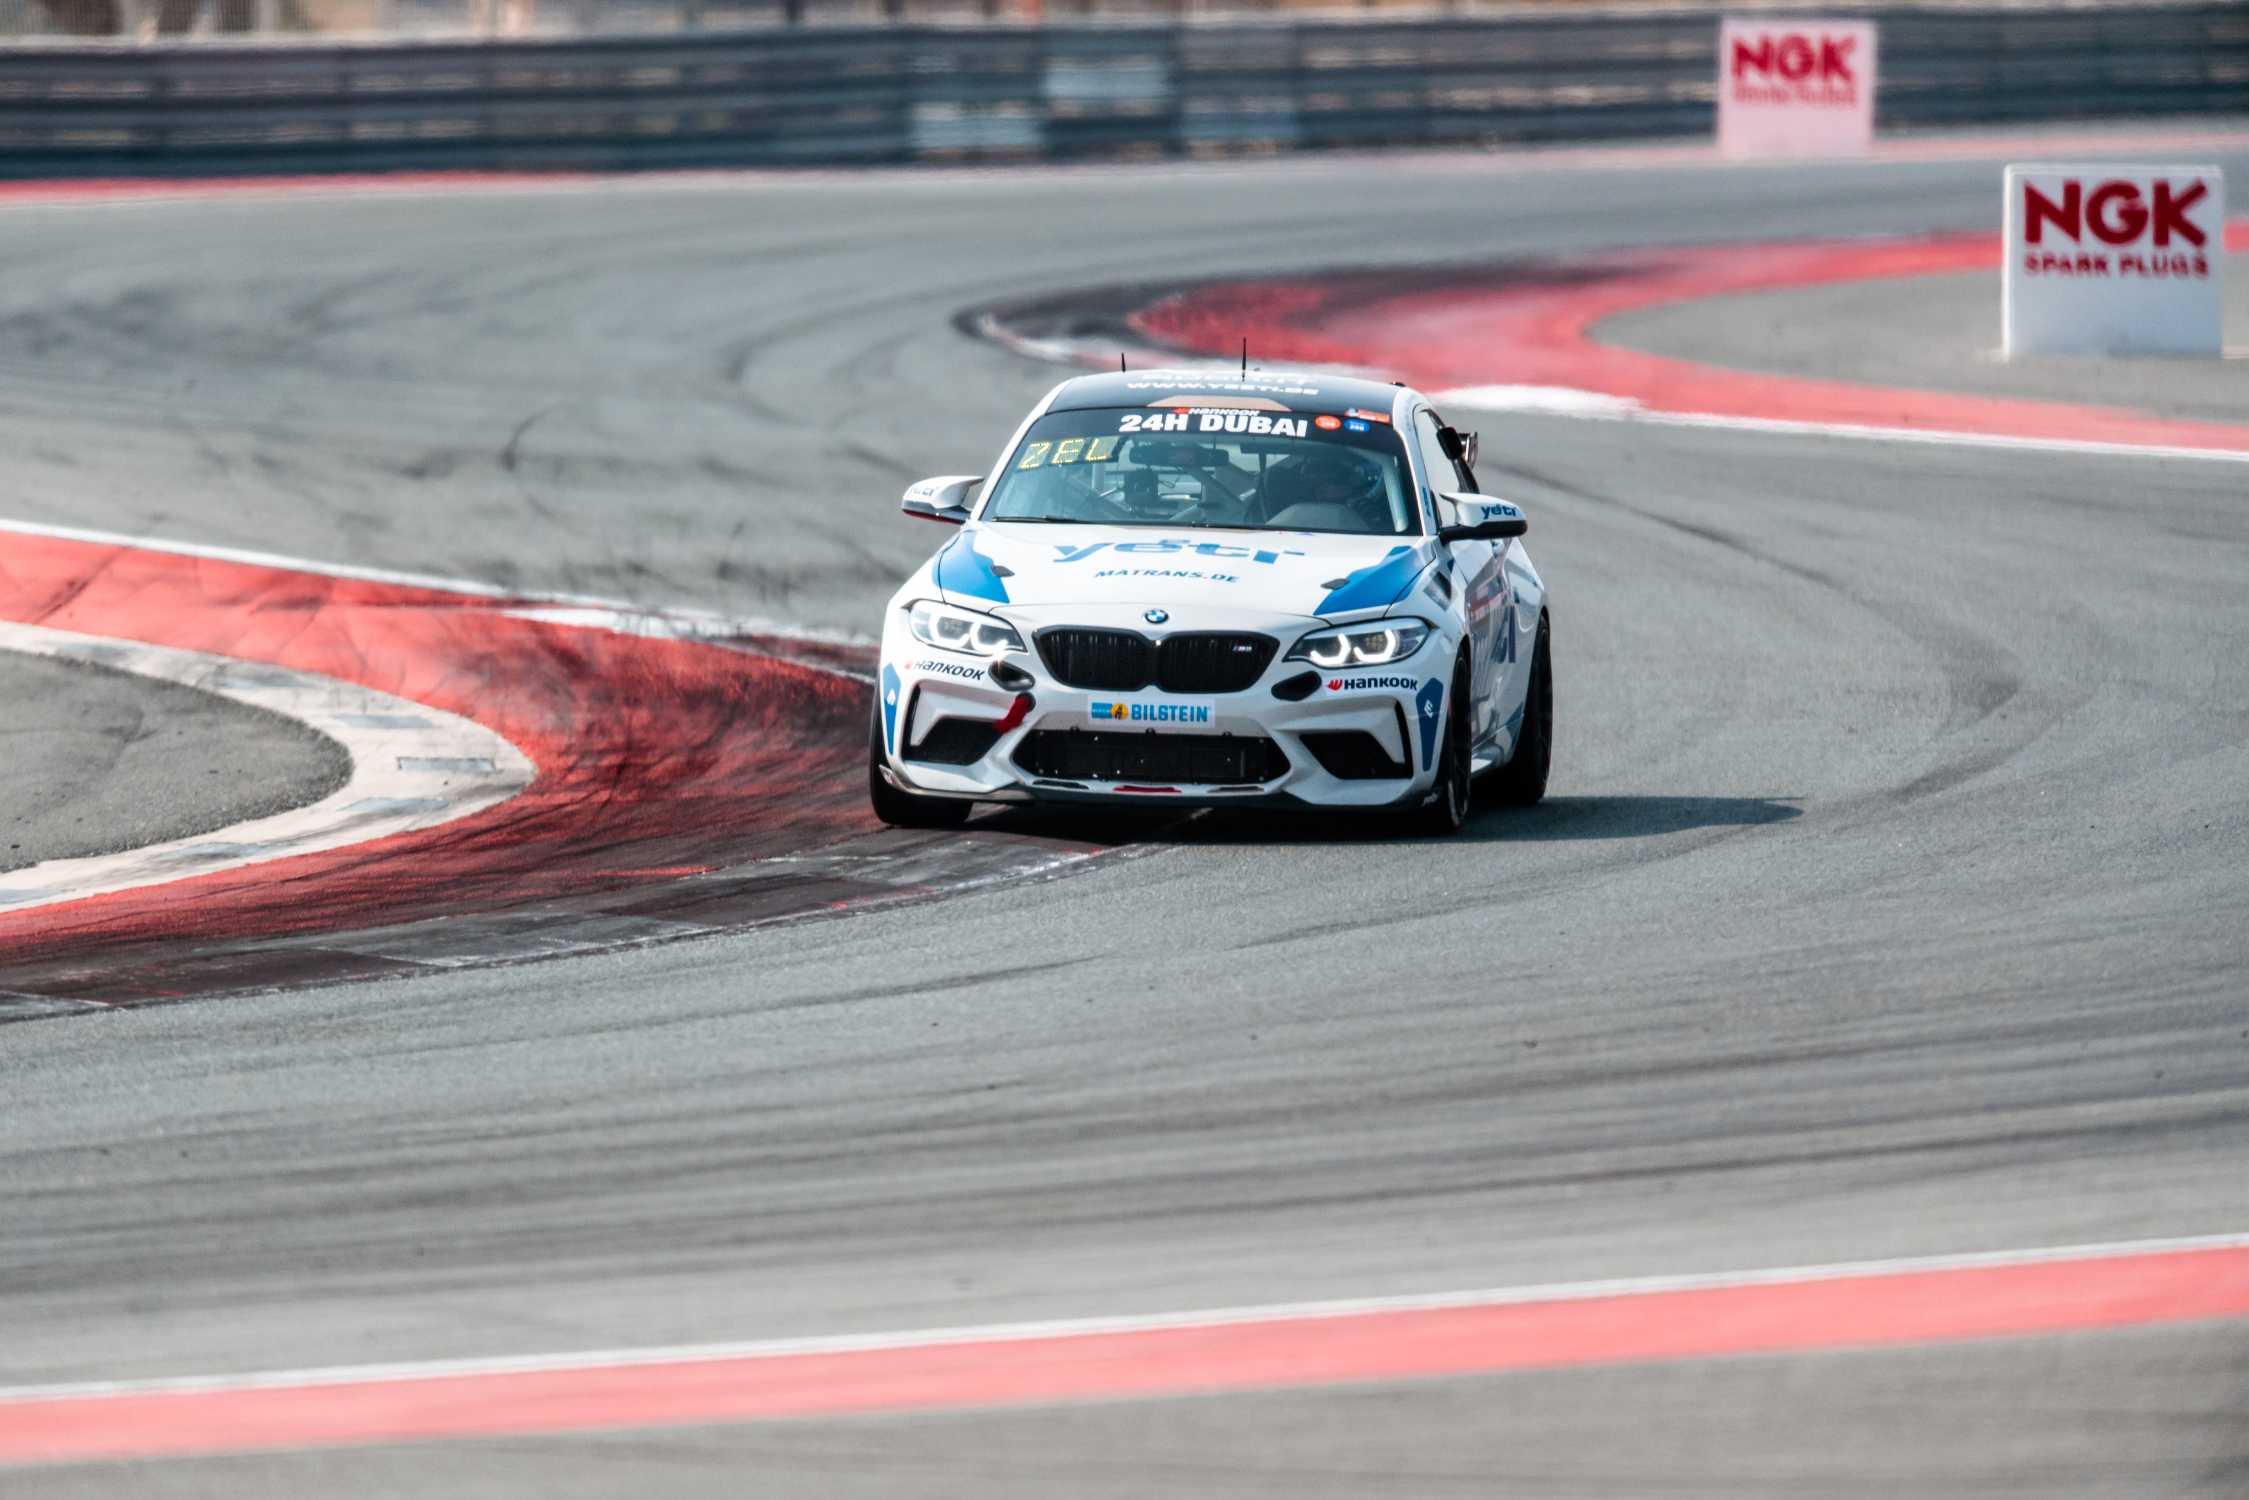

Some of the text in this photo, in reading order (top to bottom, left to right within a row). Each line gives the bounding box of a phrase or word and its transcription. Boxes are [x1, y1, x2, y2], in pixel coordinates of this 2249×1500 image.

[1732, 33, 1856, 81] NGK
[2024, 178, 2207, 247] NGK
[2025, 254, 2209, 278] SPARK PLUGS
[1118, 413, 1189, 433] 24H
[1199, 414, 1308, 438] DUBAI
[1093, 568, 1241, 584] MATRANS.DE
[1131, 703, 1209, 723] BILSTEIN
